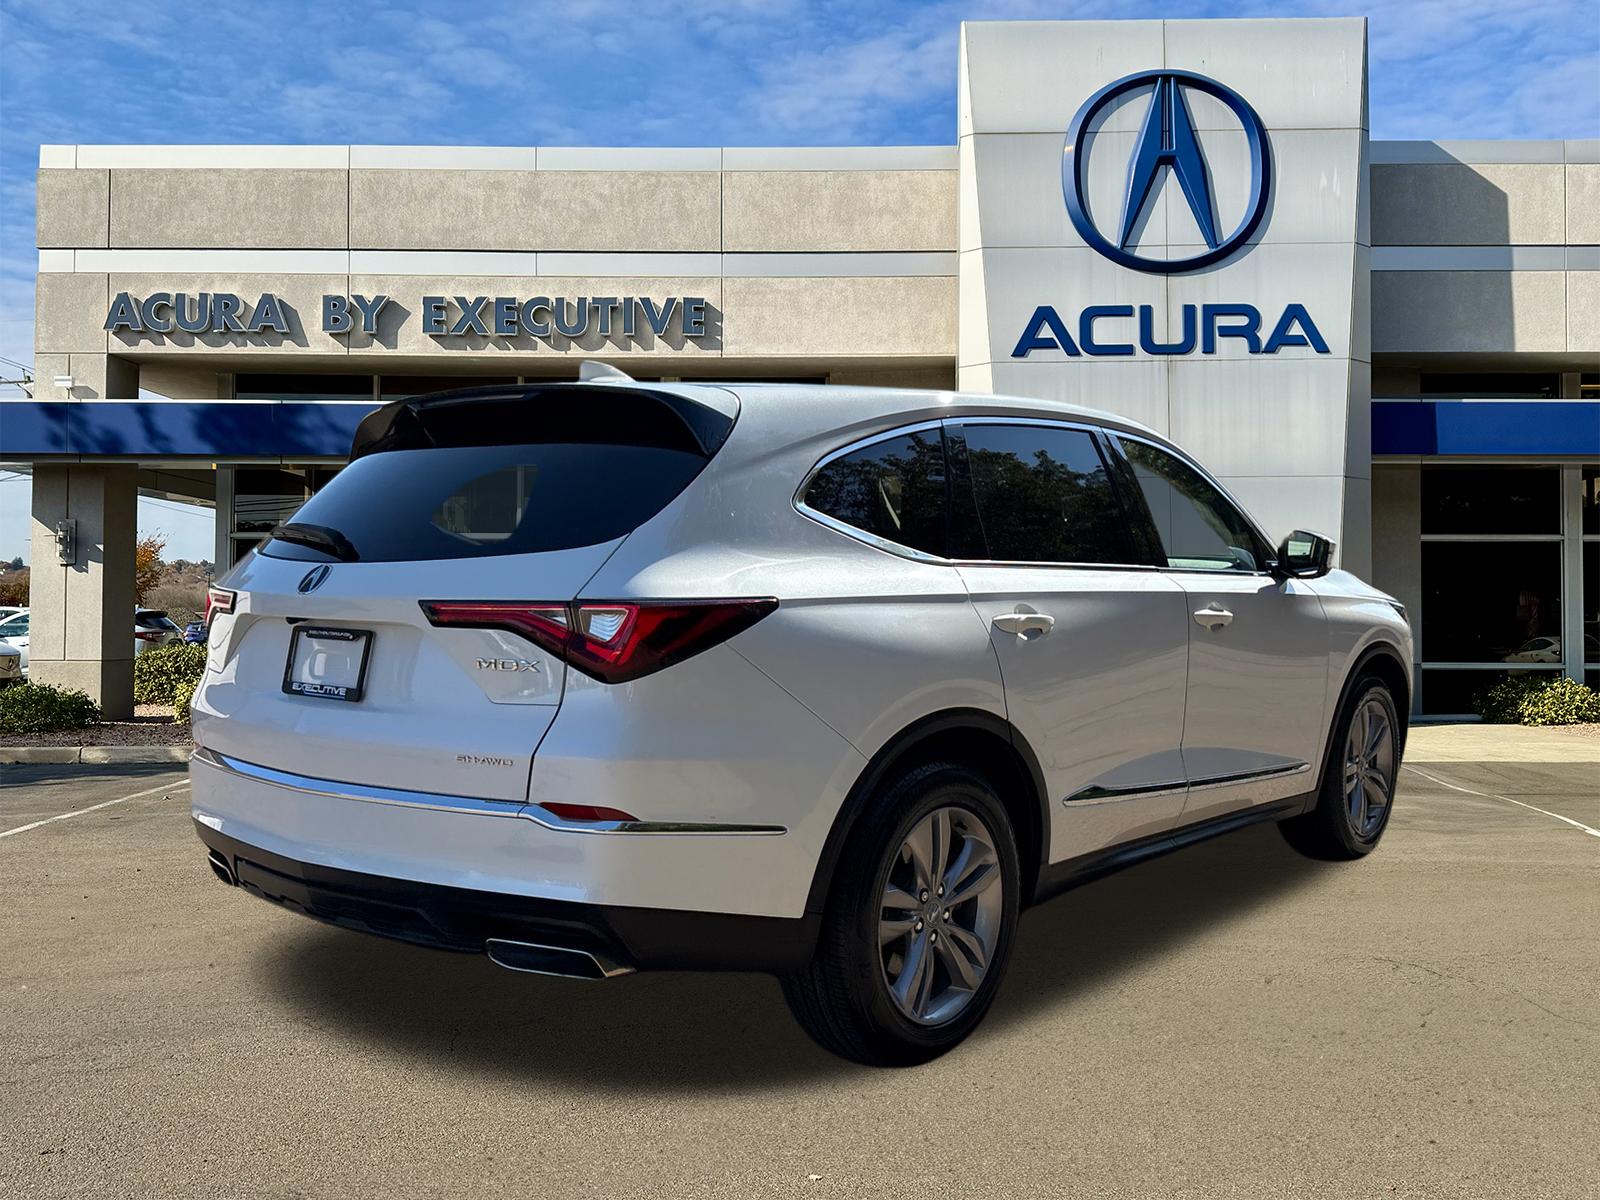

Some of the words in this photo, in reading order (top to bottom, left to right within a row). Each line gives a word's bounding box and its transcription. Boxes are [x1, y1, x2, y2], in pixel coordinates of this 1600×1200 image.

[103, 292, 291, 333] ACURA
[322, 294, 391, 334] BY
[422, 296, 706, 337] EXECUTIVE
[1010, 303, 1331, 357] ACURA
[475, 657, 541, 673] MDX
[292, 682, 346, 696] EXECUTIVE
